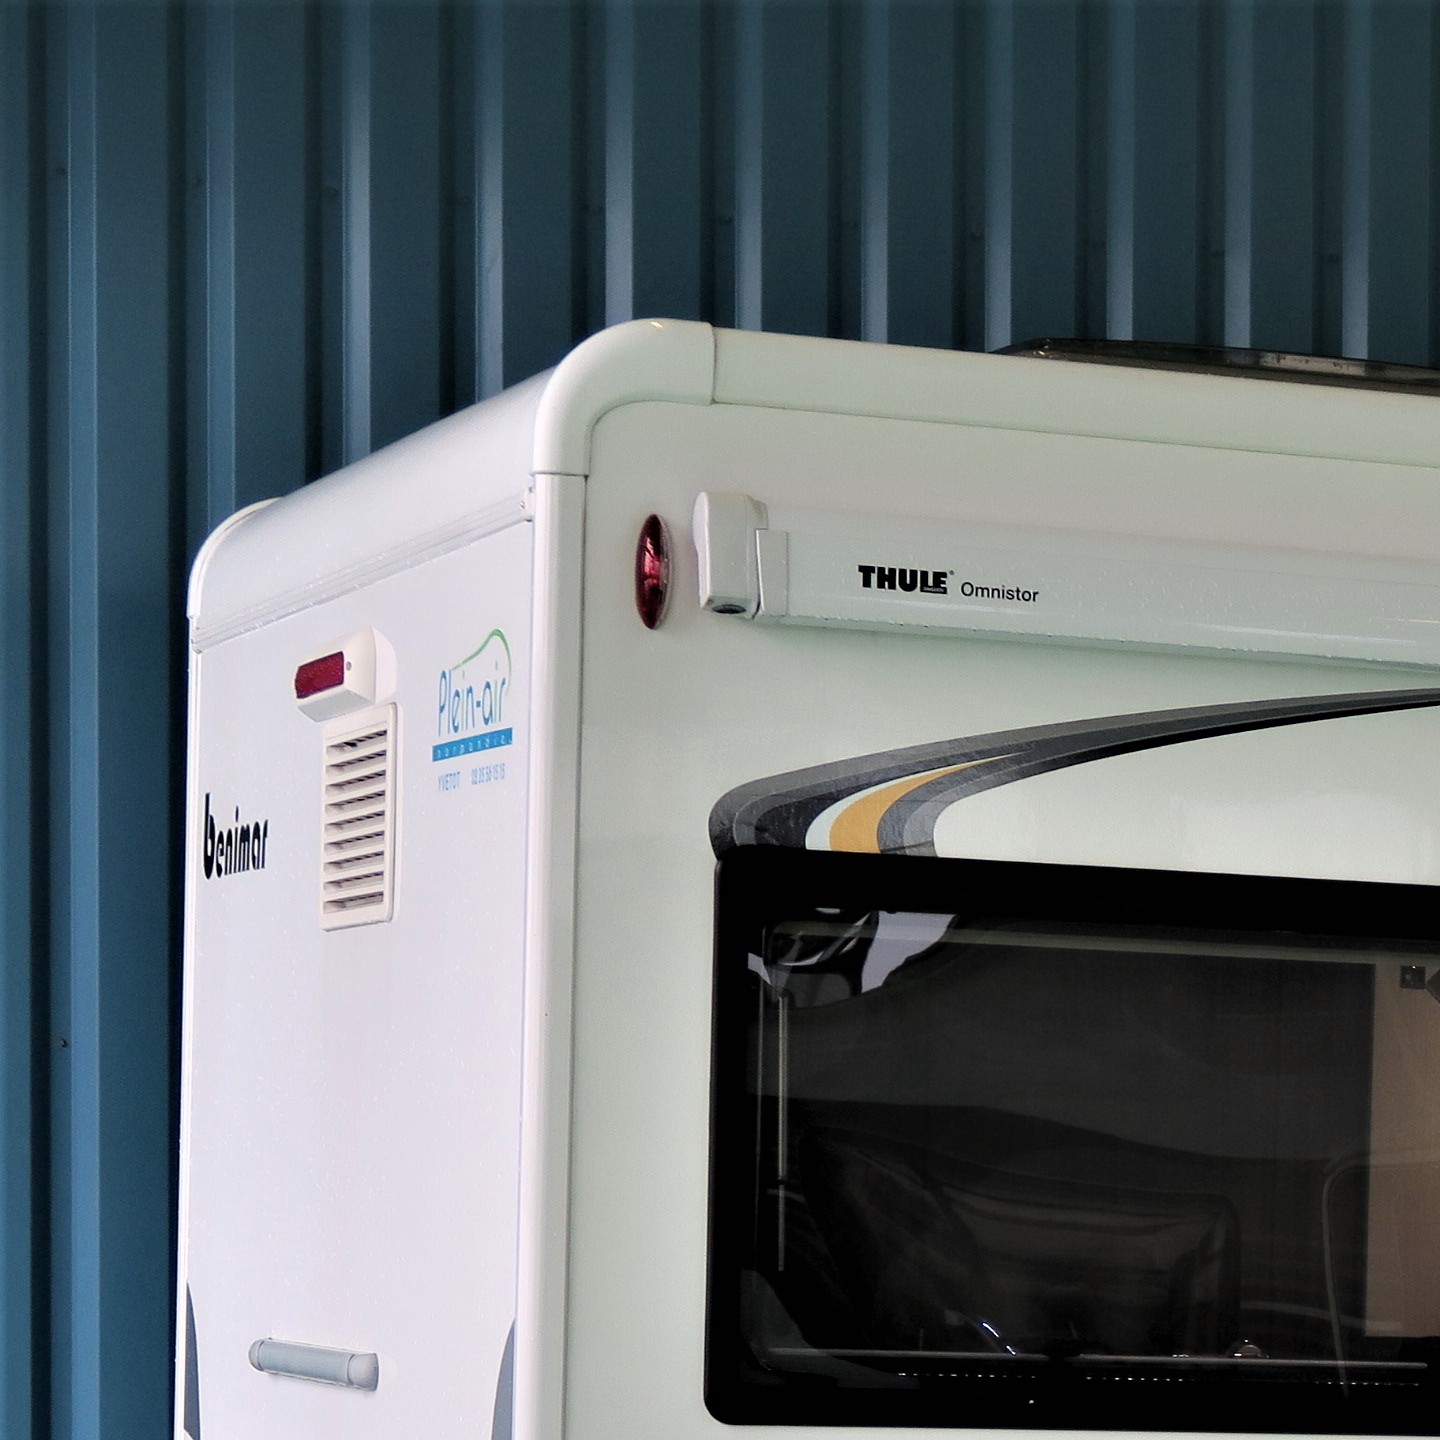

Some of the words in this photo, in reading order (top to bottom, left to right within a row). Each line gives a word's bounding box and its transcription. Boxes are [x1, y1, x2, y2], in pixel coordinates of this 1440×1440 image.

[858, 565, 948, 595] THULE
[961, 582, 1039, 602] Omnistor
[438, 659, 506, 737] Plein-air
[203, 793, 269, 880] benimar
